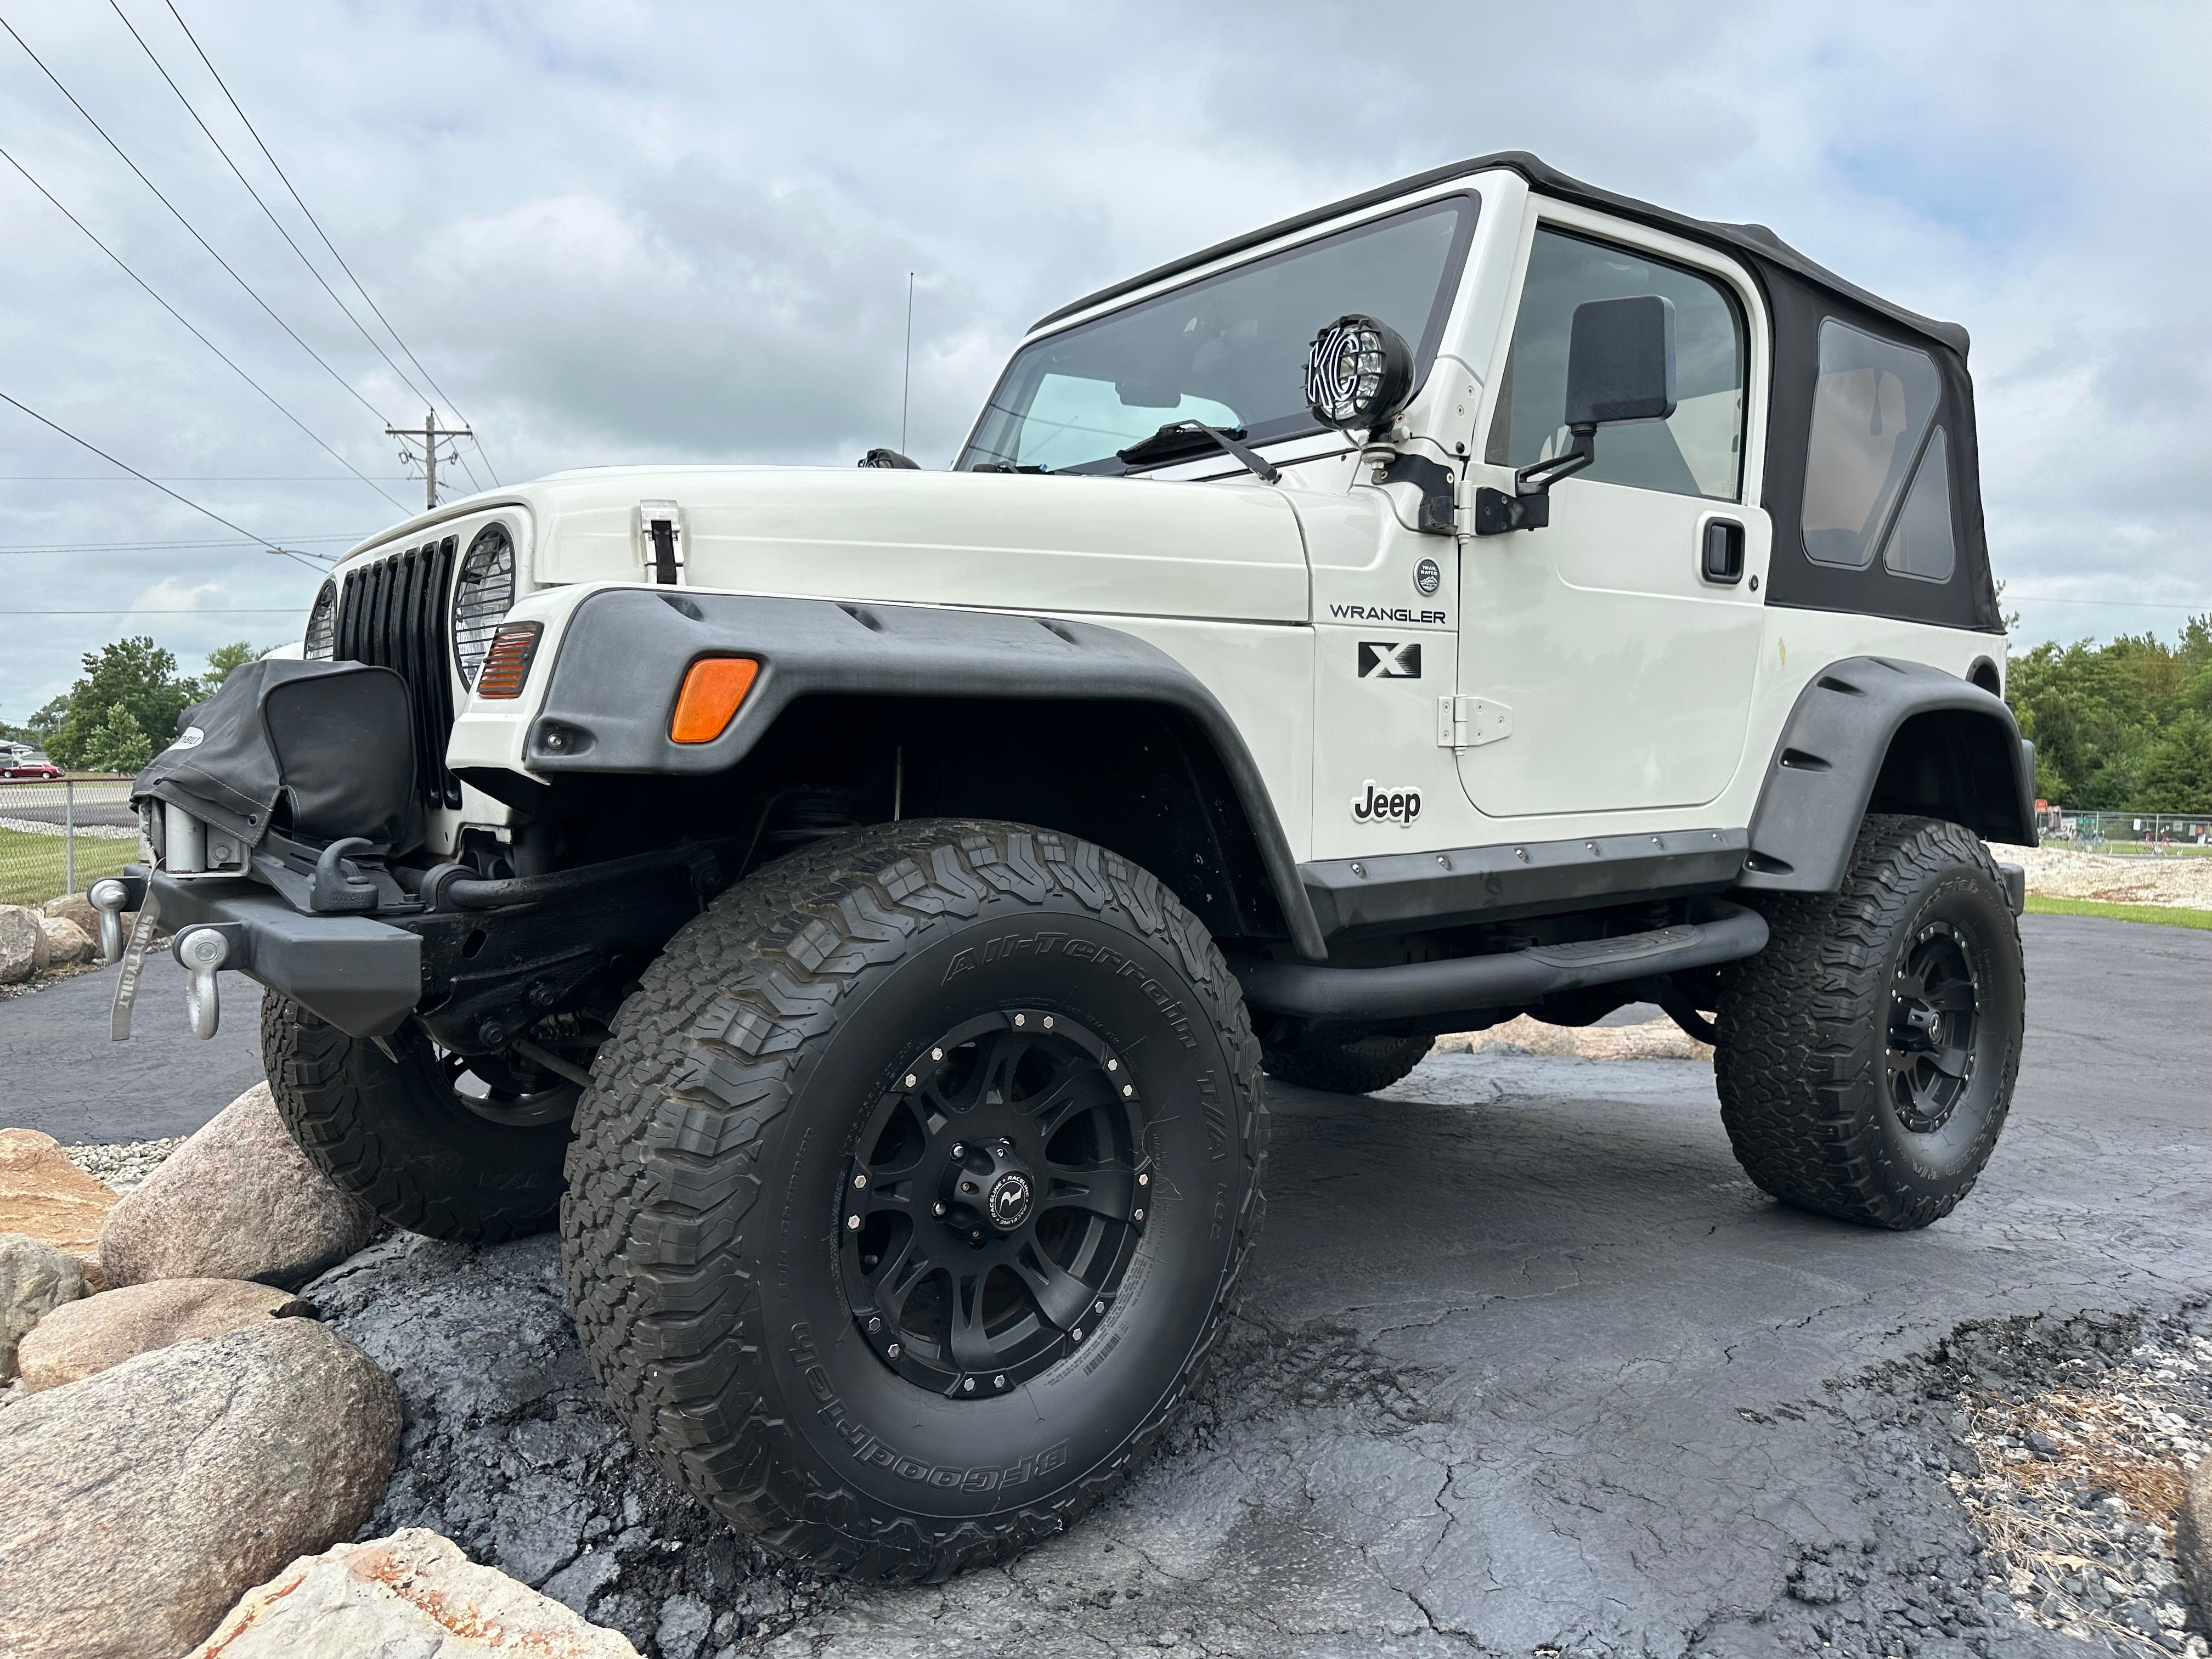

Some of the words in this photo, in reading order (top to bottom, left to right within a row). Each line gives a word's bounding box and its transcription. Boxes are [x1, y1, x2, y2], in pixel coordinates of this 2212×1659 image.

[1308, 328, 1359, 408] KC
[1330, 604, 1446, 624] WRANGLER
[1355, 786, 1420, 823] Jeep
[941, 932, 1198, 1050] All-Terrain
[1197, 1070, 1226, 1163] T/A
[989, 1181, 1002, 1218] RACELINE
[1007, 1175, 1029, 1197] RACELINE
[789, 1322, 1070, 1494] BFGoodrich
